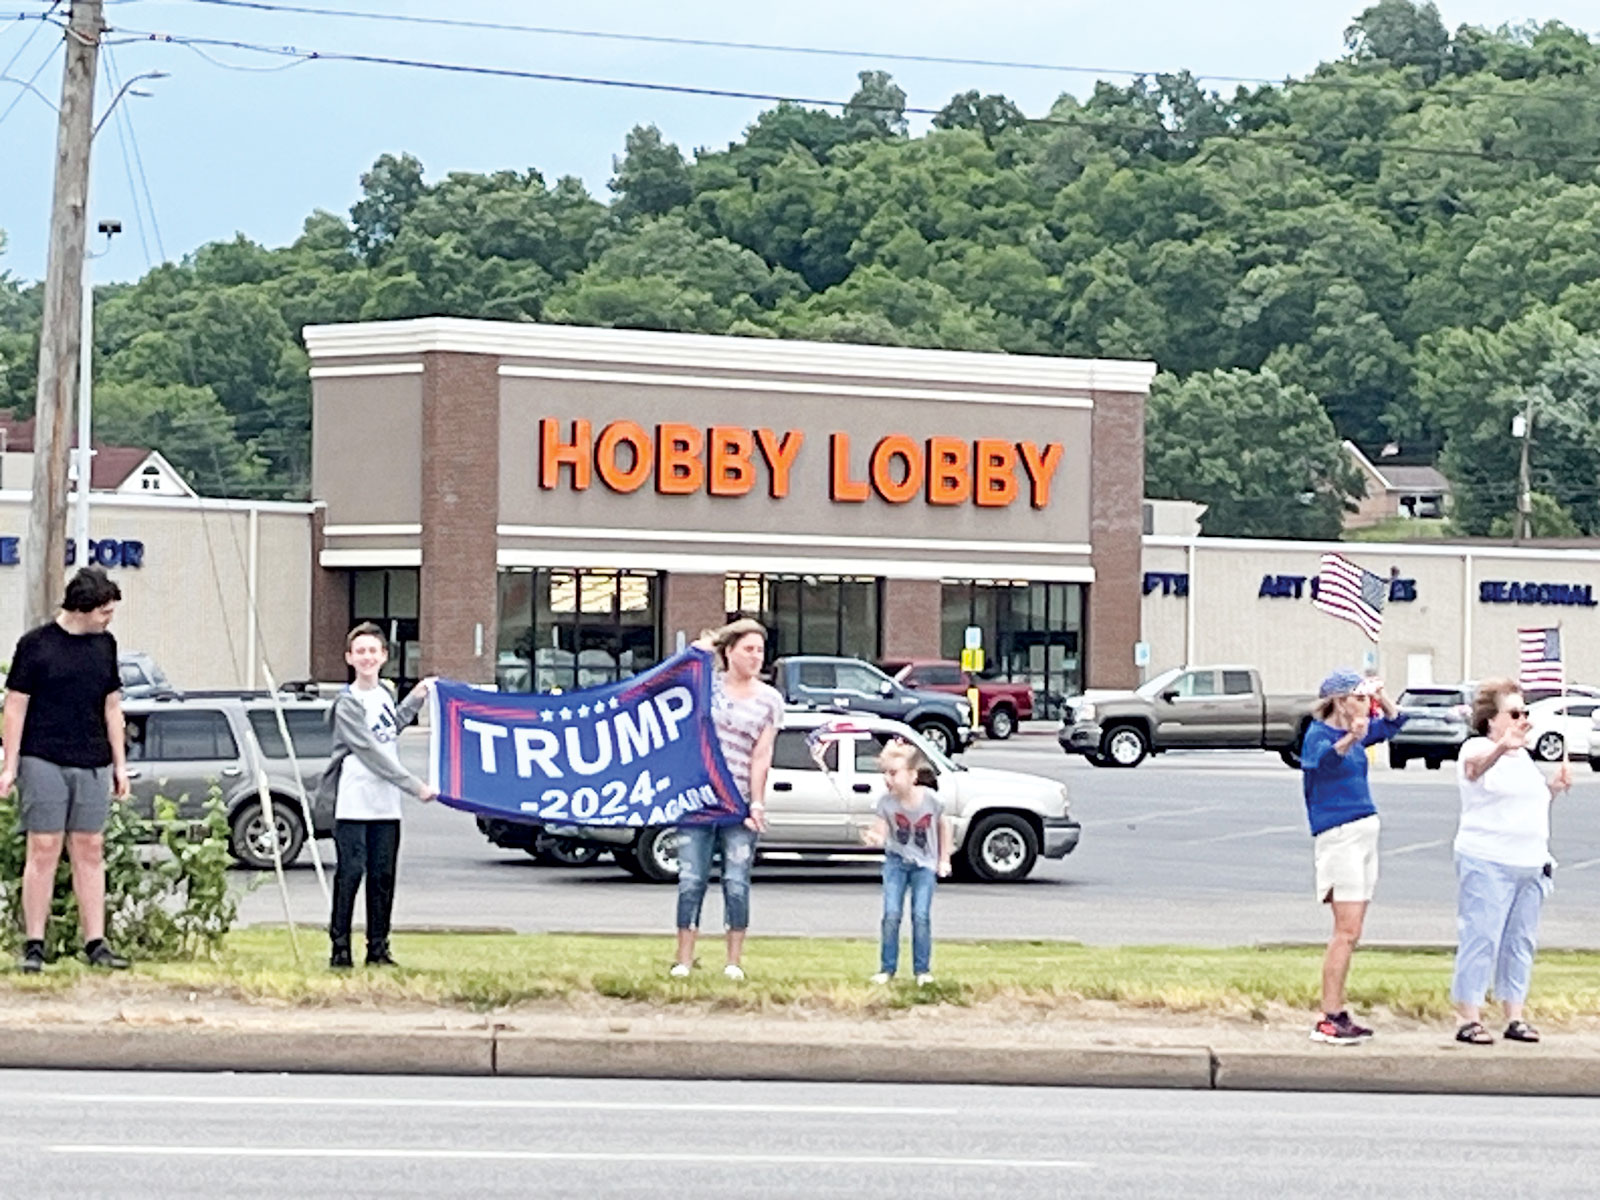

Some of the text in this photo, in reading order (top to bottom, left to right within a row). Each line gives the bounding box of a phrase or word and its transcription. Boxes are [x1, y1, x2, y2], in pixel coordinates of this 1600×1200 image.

[538, 417, 1064, 510] HOBBY LOBBY
[64, 537, 144, 568] COR
[1258, 574, 1307, 599] ART
[1479, 580, 1598, 607] SEASONAL
[463, 686, 694, 779] TRUMP
